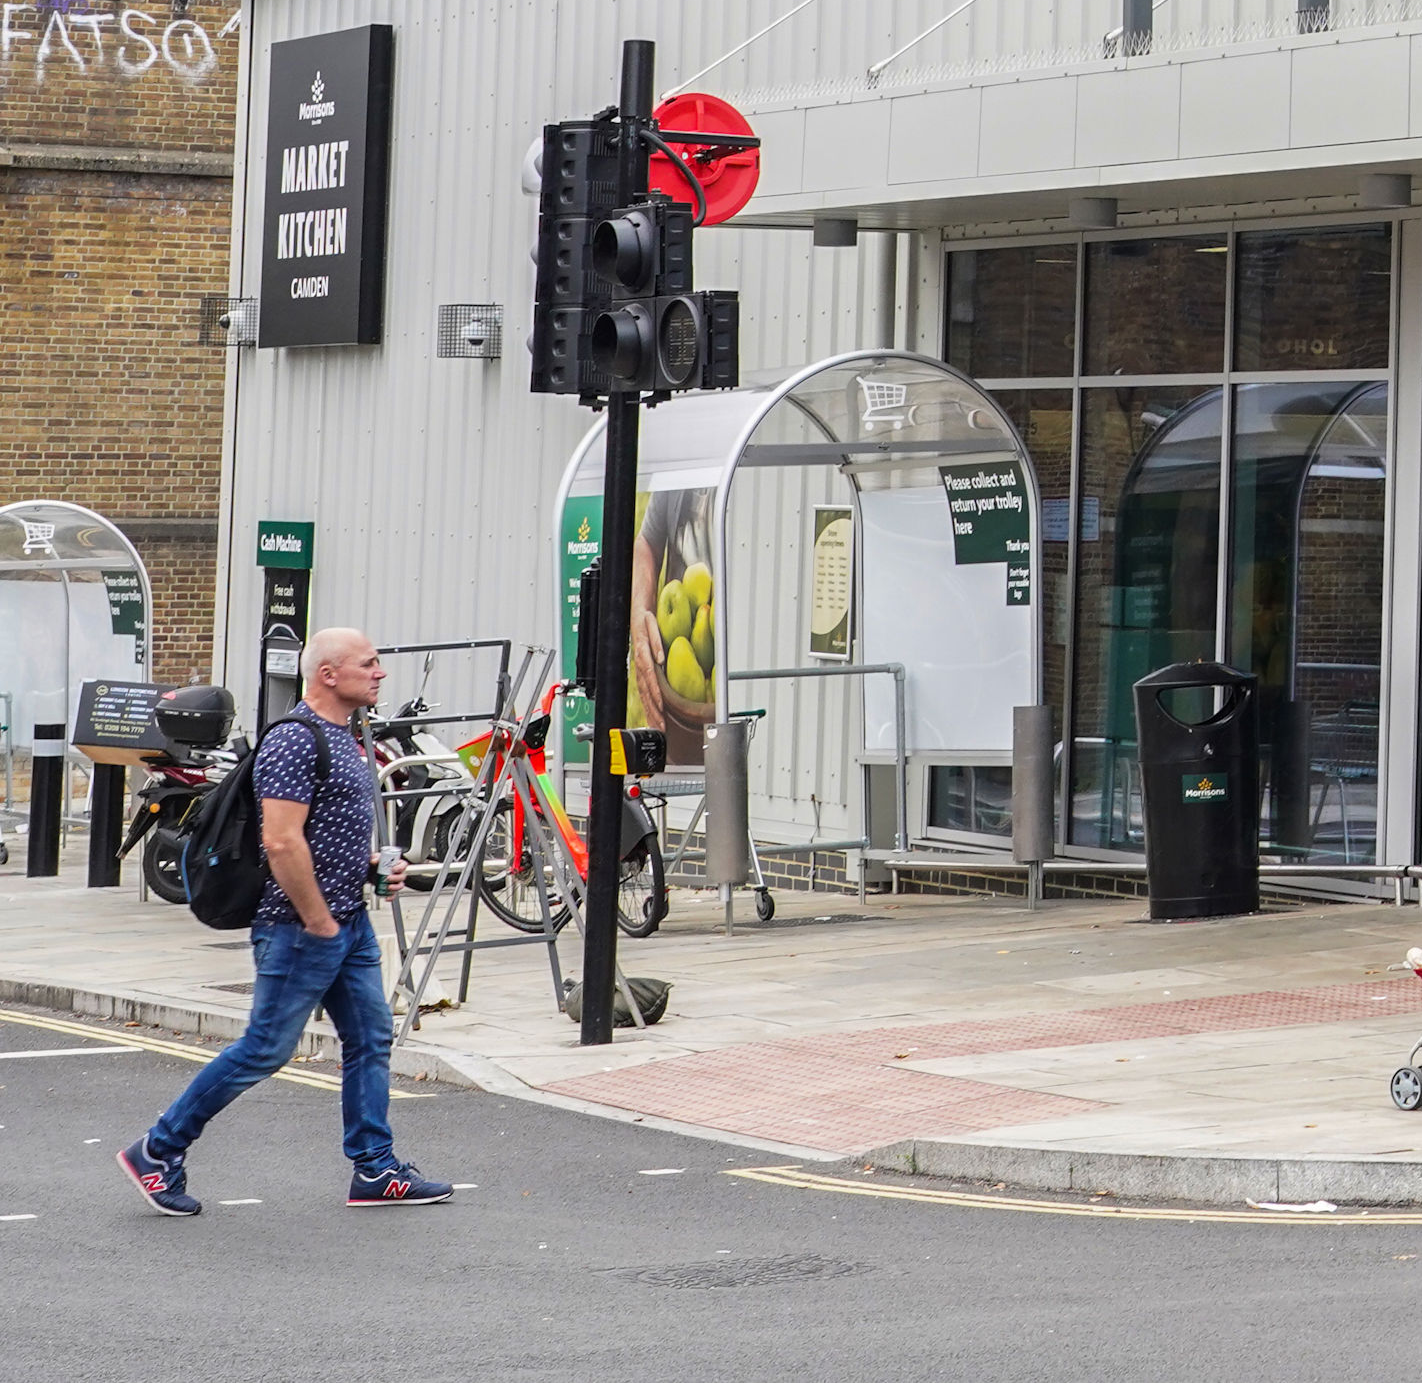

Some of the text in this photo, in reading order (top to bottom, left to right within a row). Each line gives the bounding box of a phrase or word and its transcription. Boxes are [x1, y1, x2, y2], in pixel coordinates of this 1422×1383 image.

[299, 101, 335, 120] Morrisons
[281, 140, 349, 194] MARKET
[277, 208, 347, 260] KITCHEN
[291, 276, 329, 299] CAMDEN
[944, 469, 1016, 490] Please collect and
[951, 492, 1022, 515] return your trolley
[954, 518, 973, 535] here
[260, 533, 302, 553] Cash Machine
[567, 541, 599, 555] Morrisons
[1006, 539, 1030, 553] Thank you
[1185, 788, 1225, 798] Morrisons
